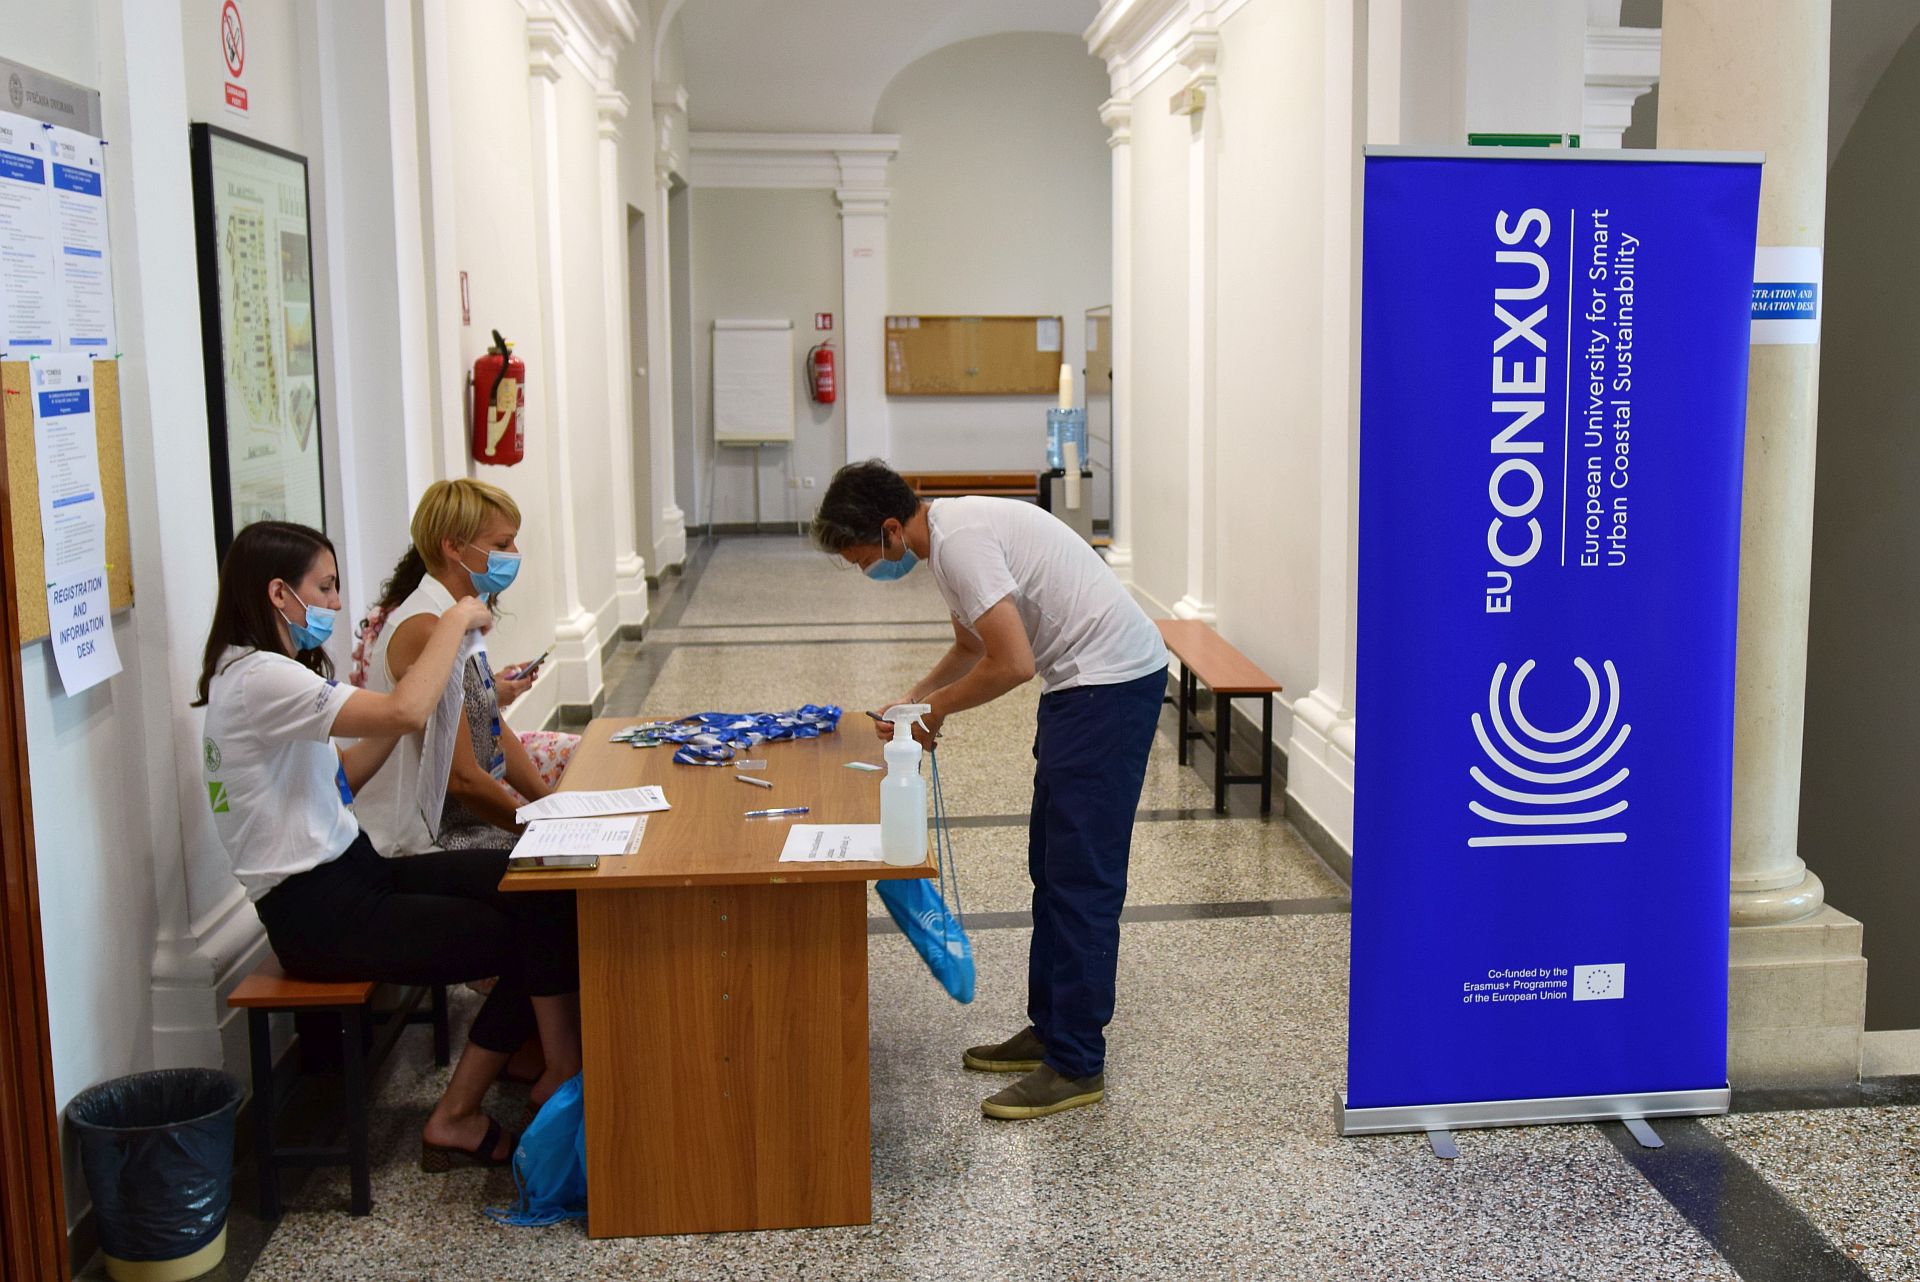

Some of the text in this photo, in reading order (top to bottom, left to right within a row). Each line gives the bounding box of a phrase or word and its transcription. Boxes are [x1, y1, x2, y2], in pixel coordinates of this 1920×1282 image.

[1798, 289, 1813, 299] AND
[1797, 301, 1815, 311] DESK
[1580, 208, 1609, 567] European University for Smart
[1607, 232, 1640, 567] Urban Coastal Sustainability
[53, 576, 102, 605] REGISTRATION
[73, 602, 87, 618] AND
[60, 616, 104, 645] INFORMATION
[76, 640, 95, 658] DESK
[1488, 967, 1568, 979] Co-funded by the
[1463, 980, 1568, 992] Erasmus+ Programme
[1463, 990, 1567, 1003] of the European Union
